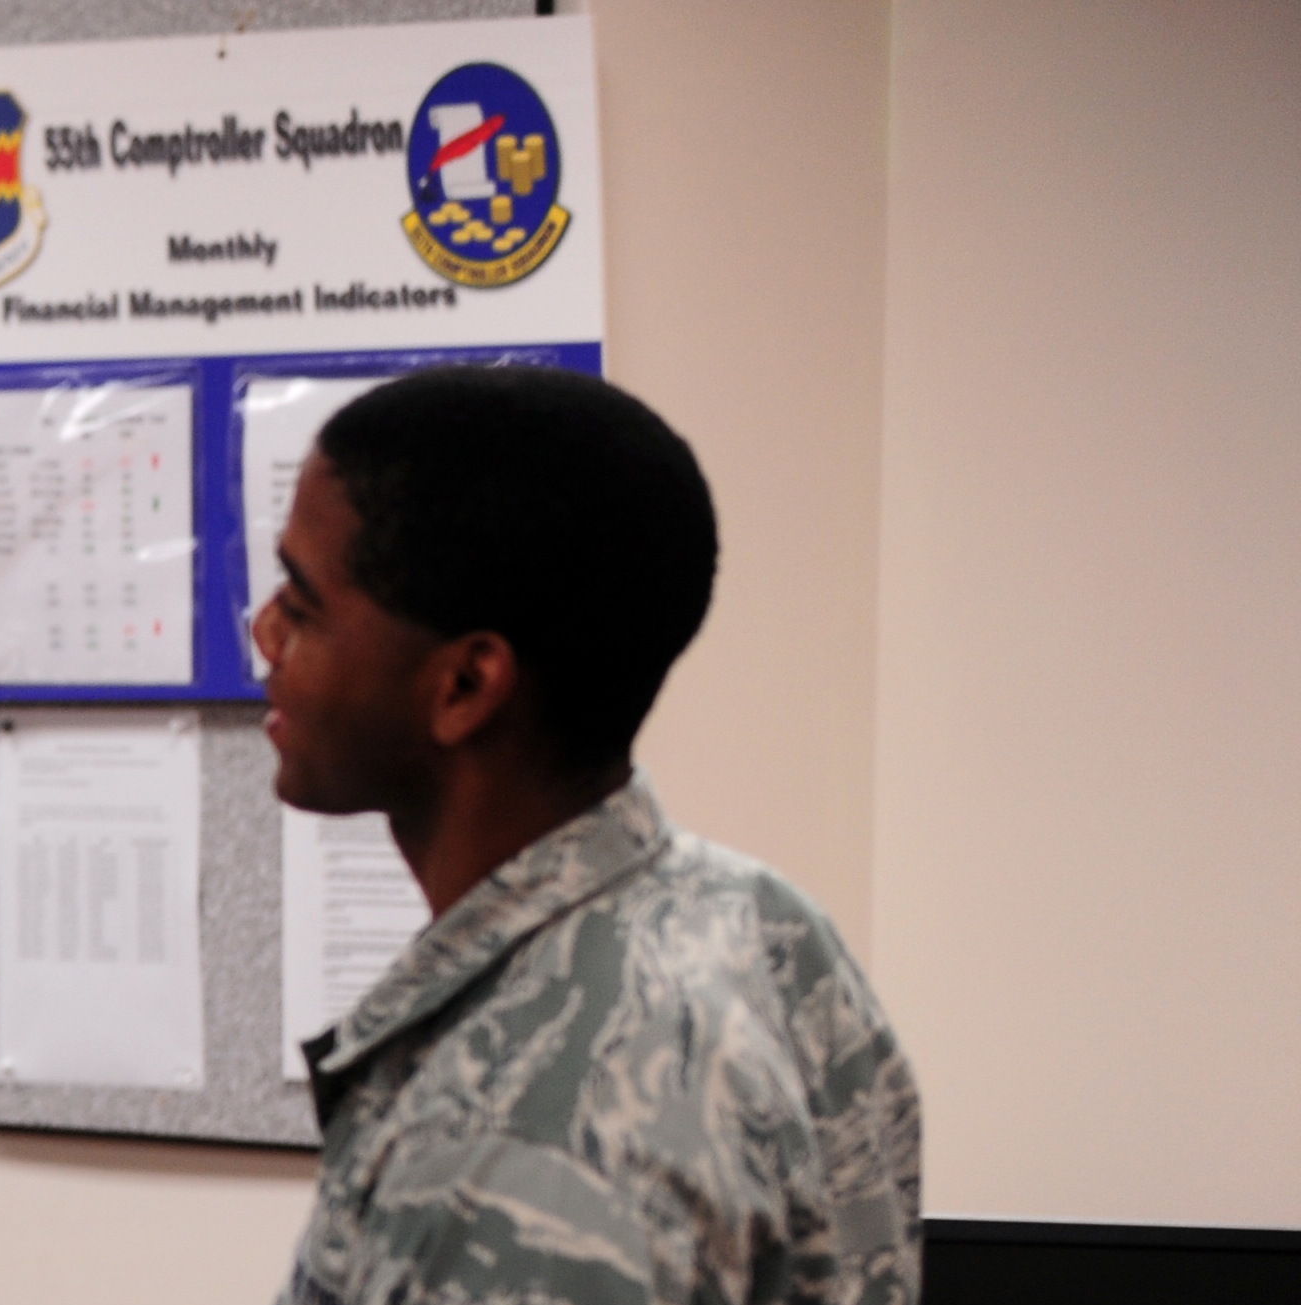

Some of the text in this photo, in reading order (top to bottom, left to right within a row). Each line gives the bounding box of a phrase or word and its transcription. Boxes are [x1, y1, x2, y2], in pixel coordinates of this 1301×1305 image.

[45, 107, 403, 178] 55th Comptroller Squadron
[167, 234, 277, 267] Monthly
[3, 282, 457, 323] Financial Management Indicators
